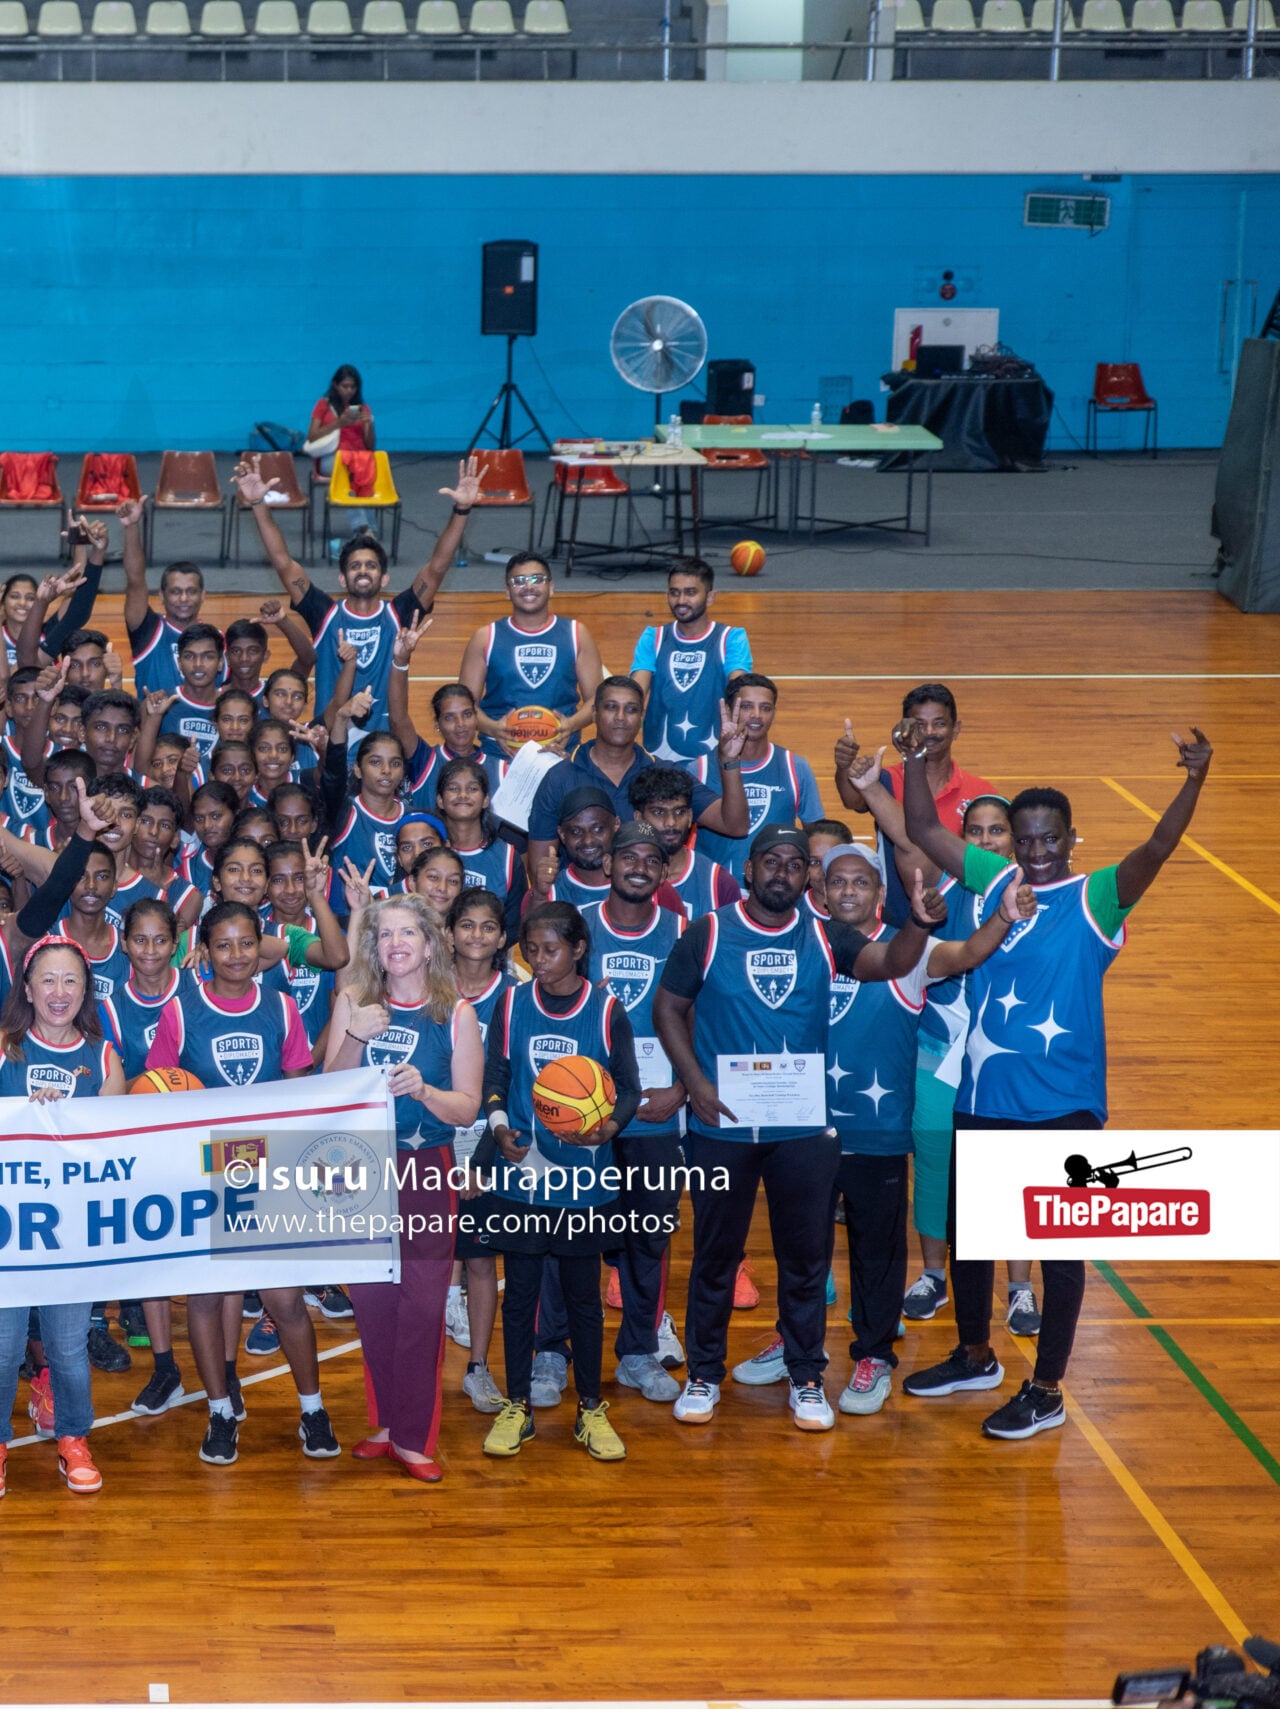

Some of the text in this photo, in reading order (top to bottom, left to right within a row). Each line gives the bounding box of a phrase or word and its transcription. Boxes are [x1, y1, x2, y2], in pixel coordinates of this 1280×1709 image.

[520, 648, 554, 658] SPORTS
[185, 722, 218, 736] SPORTS
[609, 957, 649, 971] SPORTS
[753, 953, 794, 966] SPORTS
[219, 1038, 258, 1052] SPORTS
[535, 1039, 573, 1054] SPORTS
[32, 1068, 71, 1085] SPORTS
[62, 1156, 137, 1185] PLAY
[87, 1183, 261, 1247] HOPE
